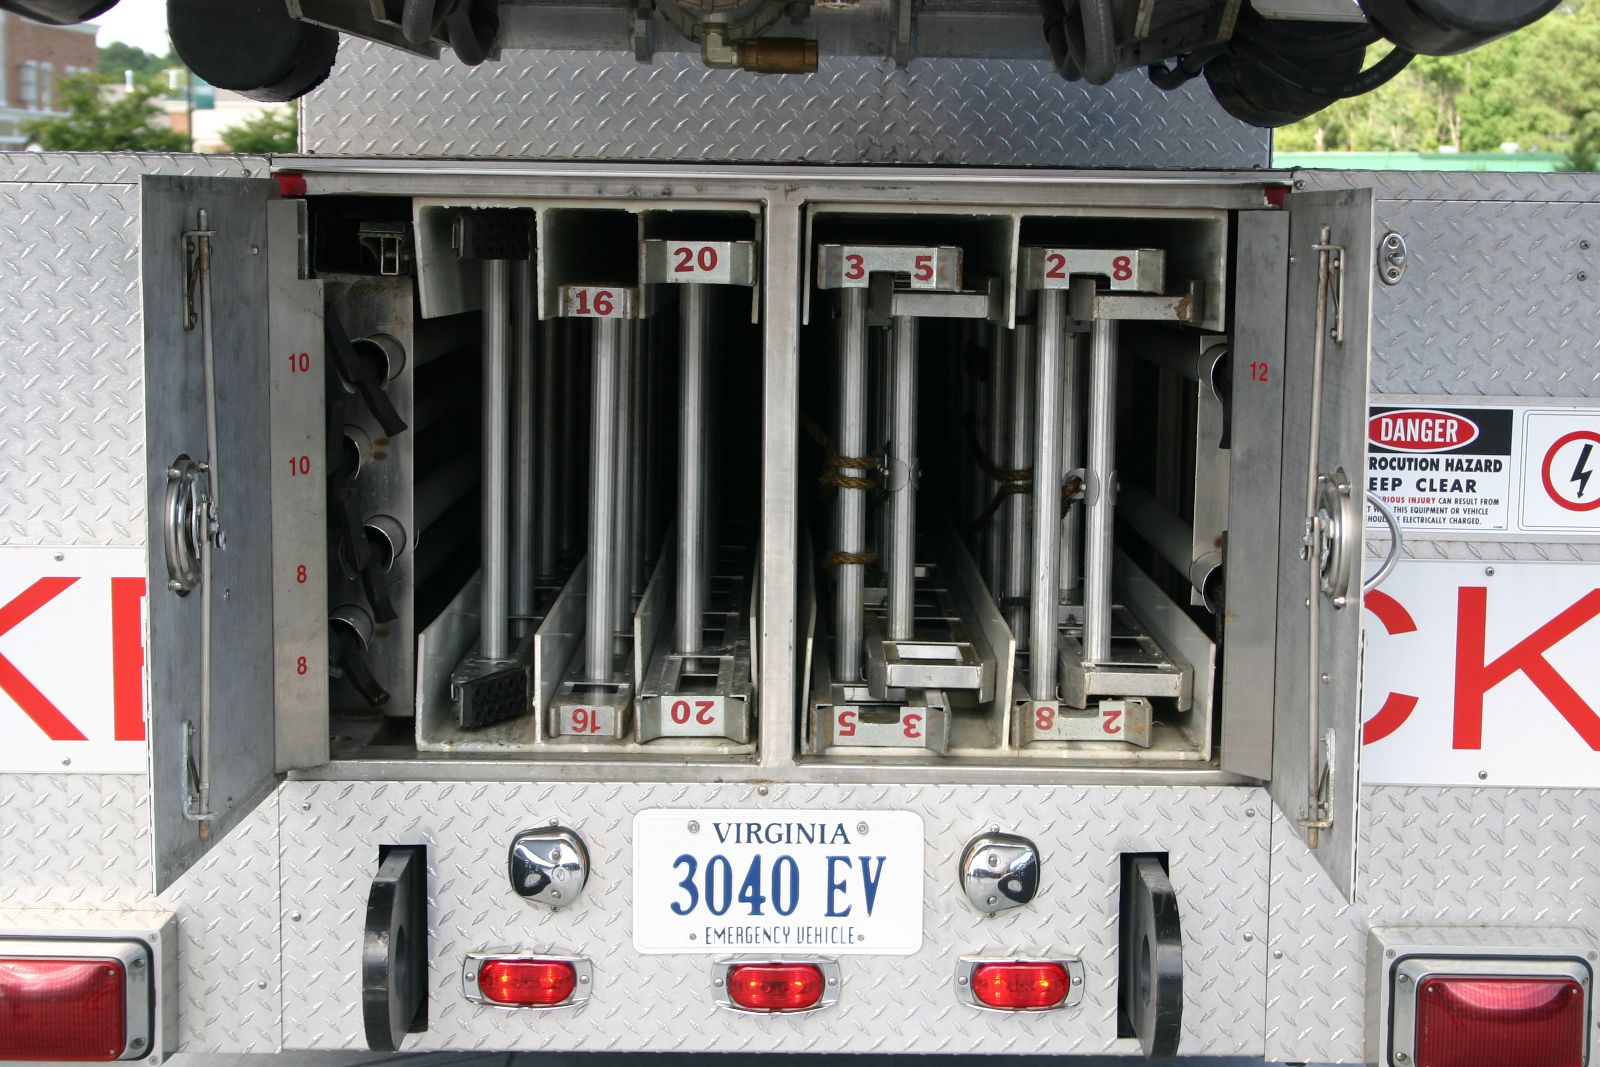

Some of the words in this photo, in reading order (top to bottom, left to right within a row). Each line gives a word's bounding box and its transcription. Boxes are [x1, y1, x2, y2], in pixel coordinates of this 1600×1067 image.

[673, 246, 718, 272] 20
[844, 254, 865, 280] 3
[913, 255, 933, 281] 5
[1046, 253, 1066, 279] 2
[1112, 256, 1133, 281] 8
[575, 289, 613, 315] 16
[289, 352, 310, 373] 10
[1249, 361, 1268, 382] 12
[1380, 418, 1459, 443] DANGER
[289, 455, 310, 476] 10
[1368, 456, 1440, 472] ROCUTION
[1445, 458, 1503, 473] HAZARD
[1369, 477, 1403, 492] EEP
[1415, 478, 1477, 493] CLEAR
[1381, 496, 1405, 504] RIOUS
[1408, 496, 1436, 505] INJURY
[1438, 497, 1452, 505] CAN
[1454, 498, 1478, 506] RESULT
[1480, 498, 1500, 506] FROM
[1393, 506, 1408, 514] THIS
[1410, 507, 1448, 515] EQUIPMENT
[1450, 507, 1460, 515] OR
[1463, 508, 1489, 516] VEHICLE
[1402, 516, 1447, 525] ELECTRICALLY
[1449, 517, 1482, 525] CHARGED.
[296, 564, 307, 584] 8
[297, 656, 307, 675] 8
[571, 707, 601, 734] 16
[670, 699, 716, 725] 20
[837, 711, 857, 736] 5
[1035, 706, 1056, 730] 8
[1102, 710, 1122, 734] 2
[902, 713, 922, 738] 3
[712, 822, 852, 845] VIRGINIA
[670, 853, 800, 917] 3040
[824, 855, 887, 917] EV
[705, 926, 791, 945] EMERGENCY
[797, 926, 855, 945] VEHICLE
